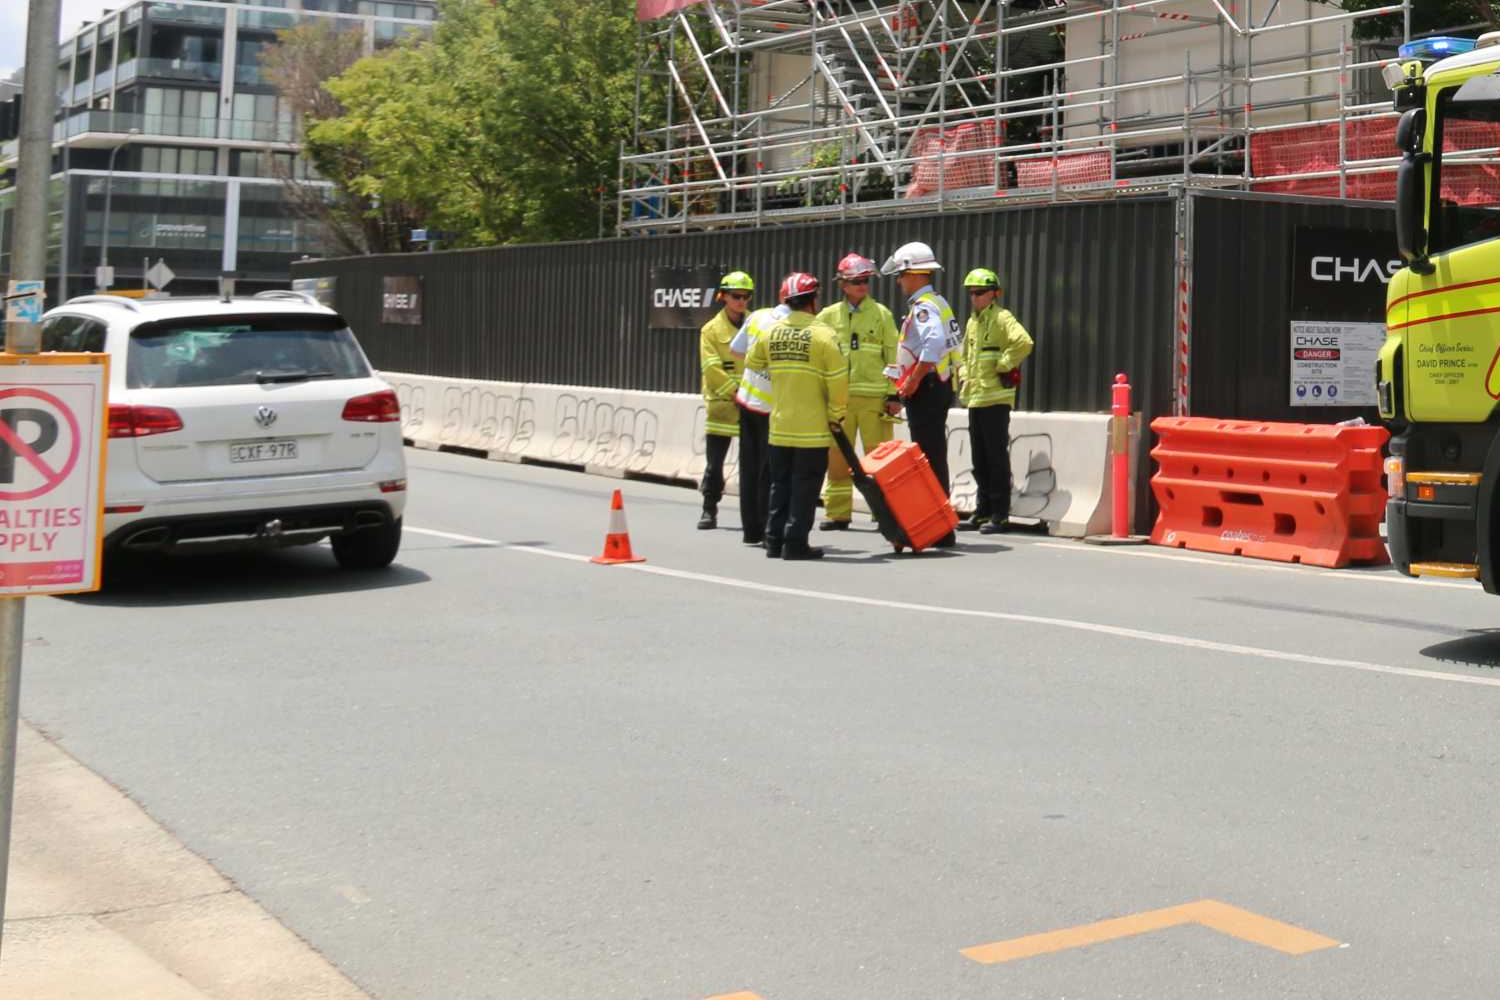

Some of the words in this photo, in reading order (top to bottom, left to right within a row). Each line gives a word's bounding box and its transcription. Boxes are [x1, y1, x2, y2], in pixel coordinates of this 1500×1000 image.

[653, 288, 701, 308] CHASE
[1296, 336, 1339, 346] CHASE
[769, 341, 810, 353] RESCUE
[1302, 350, 1332, 358] DANGER
[1417, 359, 1438, 369] DAVID
[1439, 359, 1466, 368] PRINCE
